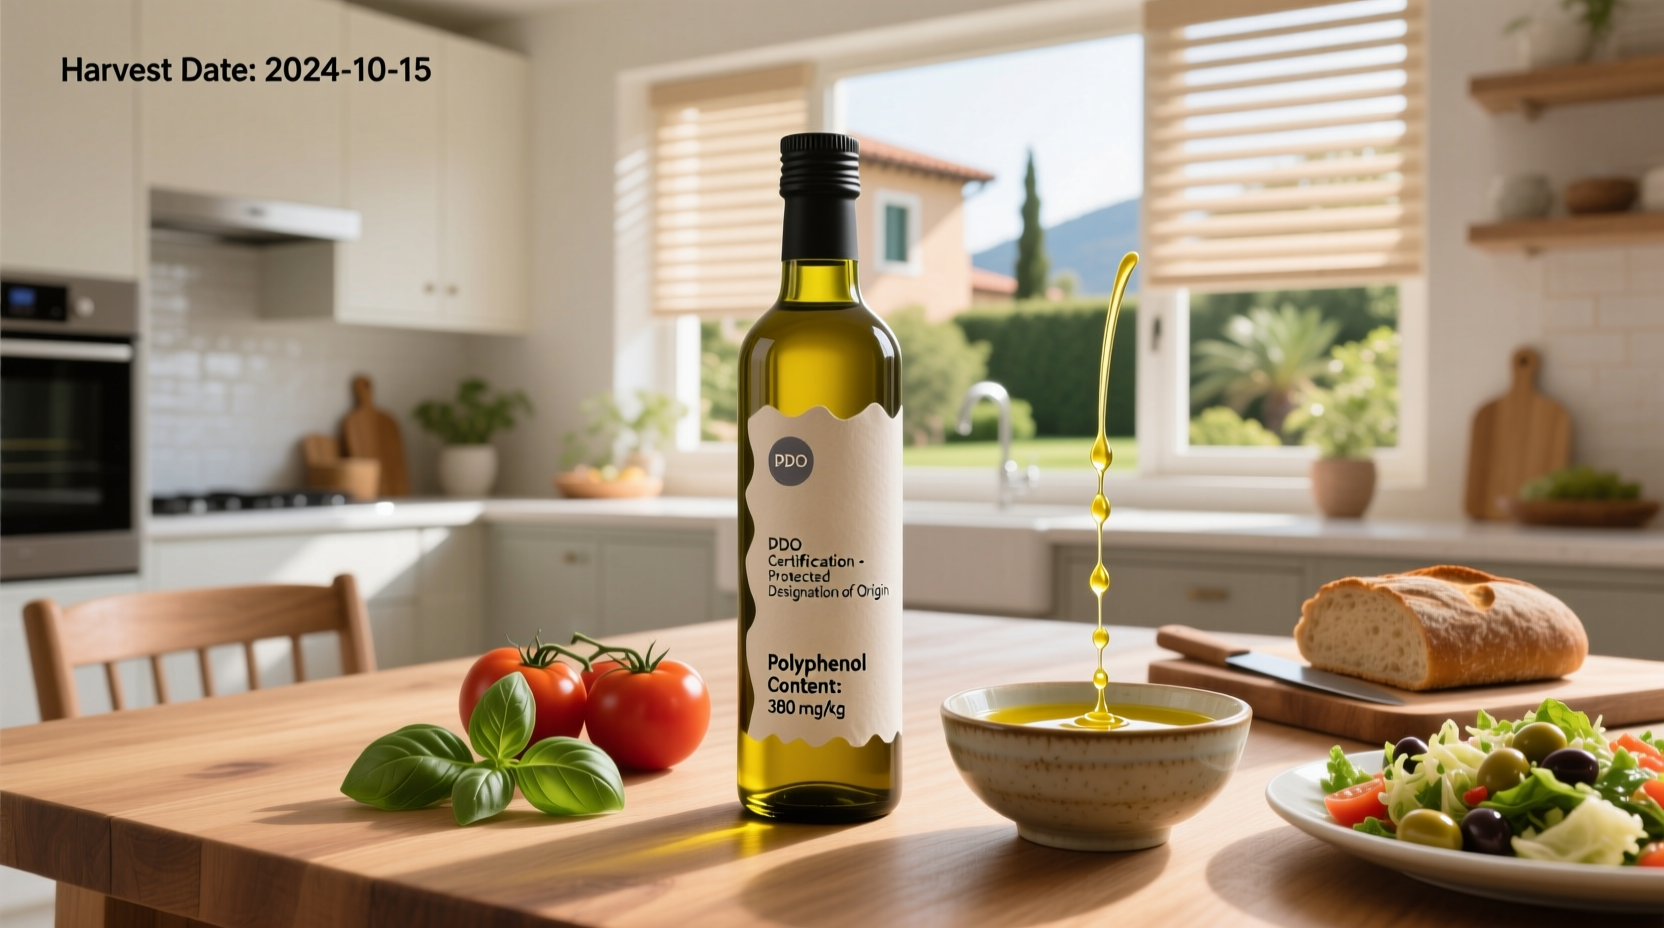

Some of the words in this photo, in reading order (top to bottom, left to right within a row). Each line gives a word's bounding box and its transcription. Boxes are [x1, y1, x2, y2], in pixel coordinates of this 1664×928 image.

[775, 453, 808, 468] PDO
[768, 537, 802, 551] PDO
[842, 584, 856, 598] of
[857, 584, 890, 600] Origin
[768, 653, 866, 677] Polyphenol
[767, 676, 842, 694] Content:
[768, 699, 796, 714] 380
[799, 700, 846, 720] mg/kg
